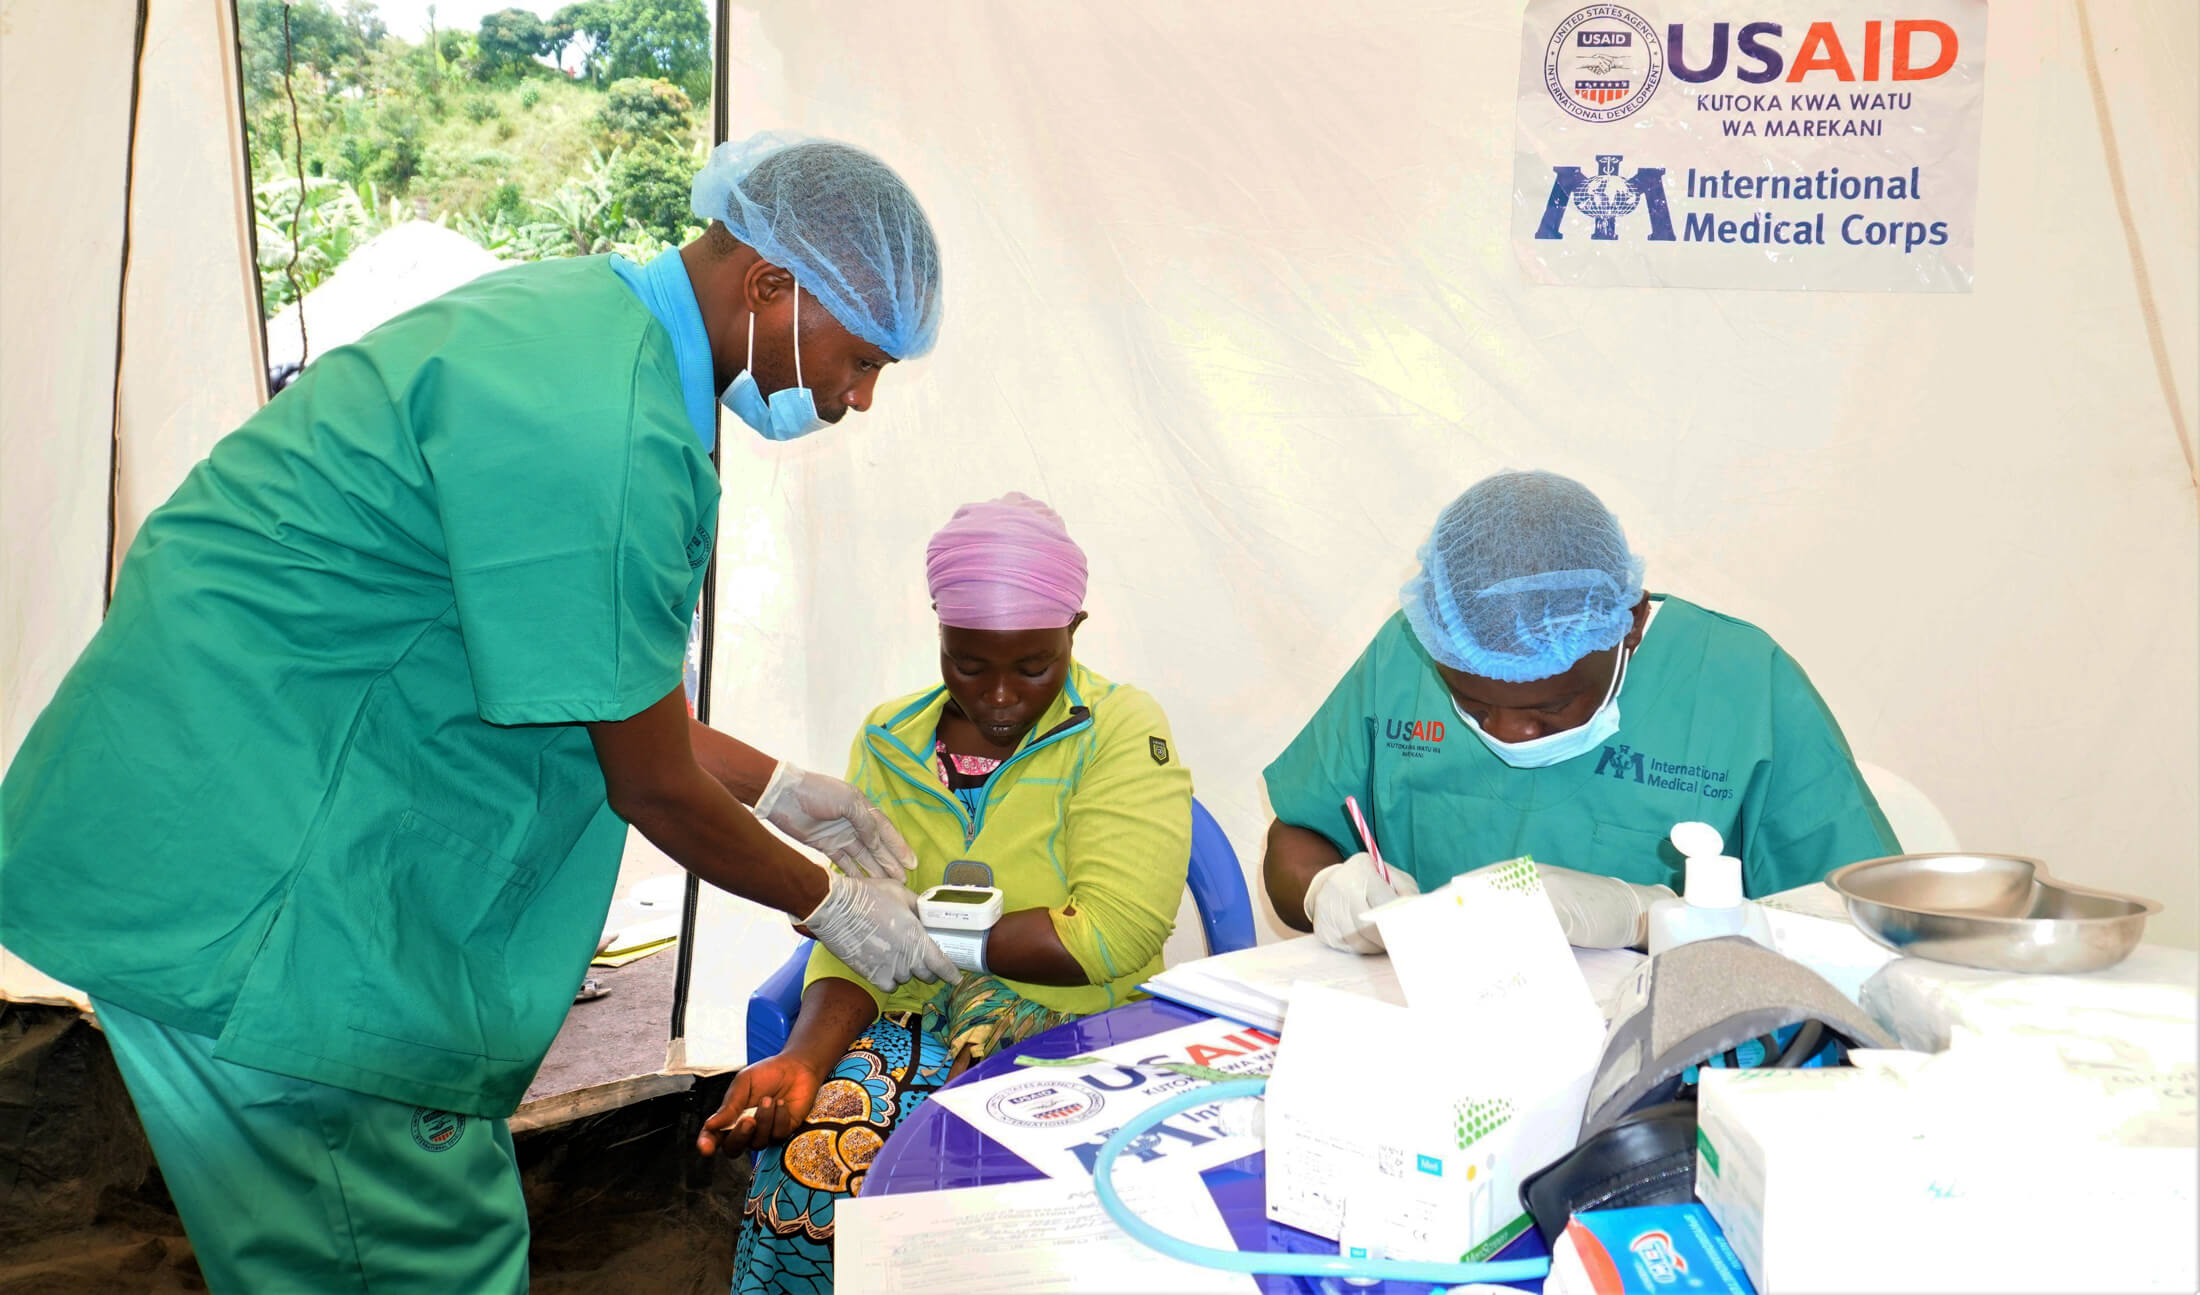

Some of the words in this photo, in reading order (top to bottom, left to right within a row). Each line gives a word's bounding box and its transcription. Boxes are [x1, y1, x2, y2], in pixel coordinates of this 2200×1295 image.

[1554, 13, 1585, 45] UNITED
[1586, 7, 1624, 18] STATES
[1624, 13, 1657, 46] AGENCY
[1582, 33, 1626, 45] USAID
[1667, 19, 1959, 84] USAID
[1547, 64, 1606, 120] INTERNATIONAL
[1606, 63, 1661, 120] DEVELOPMENT
[1697, 94, 1782, 112] KUTOKA
[1791, 93, 1842, 111] KWA
[1848, 92, 1912, 110] WATU
[1722, 119, 1757, 137] WA
[1765, 119, 1883, 137] MAREKANI
[1687, 166, 1921, 201] International
[1683, 212, 1826, 246] Medical
[1841, 214, 1949, 254] Corps
[1386, 718, 1445, 742] USAID
[1650, 758, 1730, 783] International
[1648, 774, 1698, 793] Medical
[1703, 784, 1734, 801] Corps
